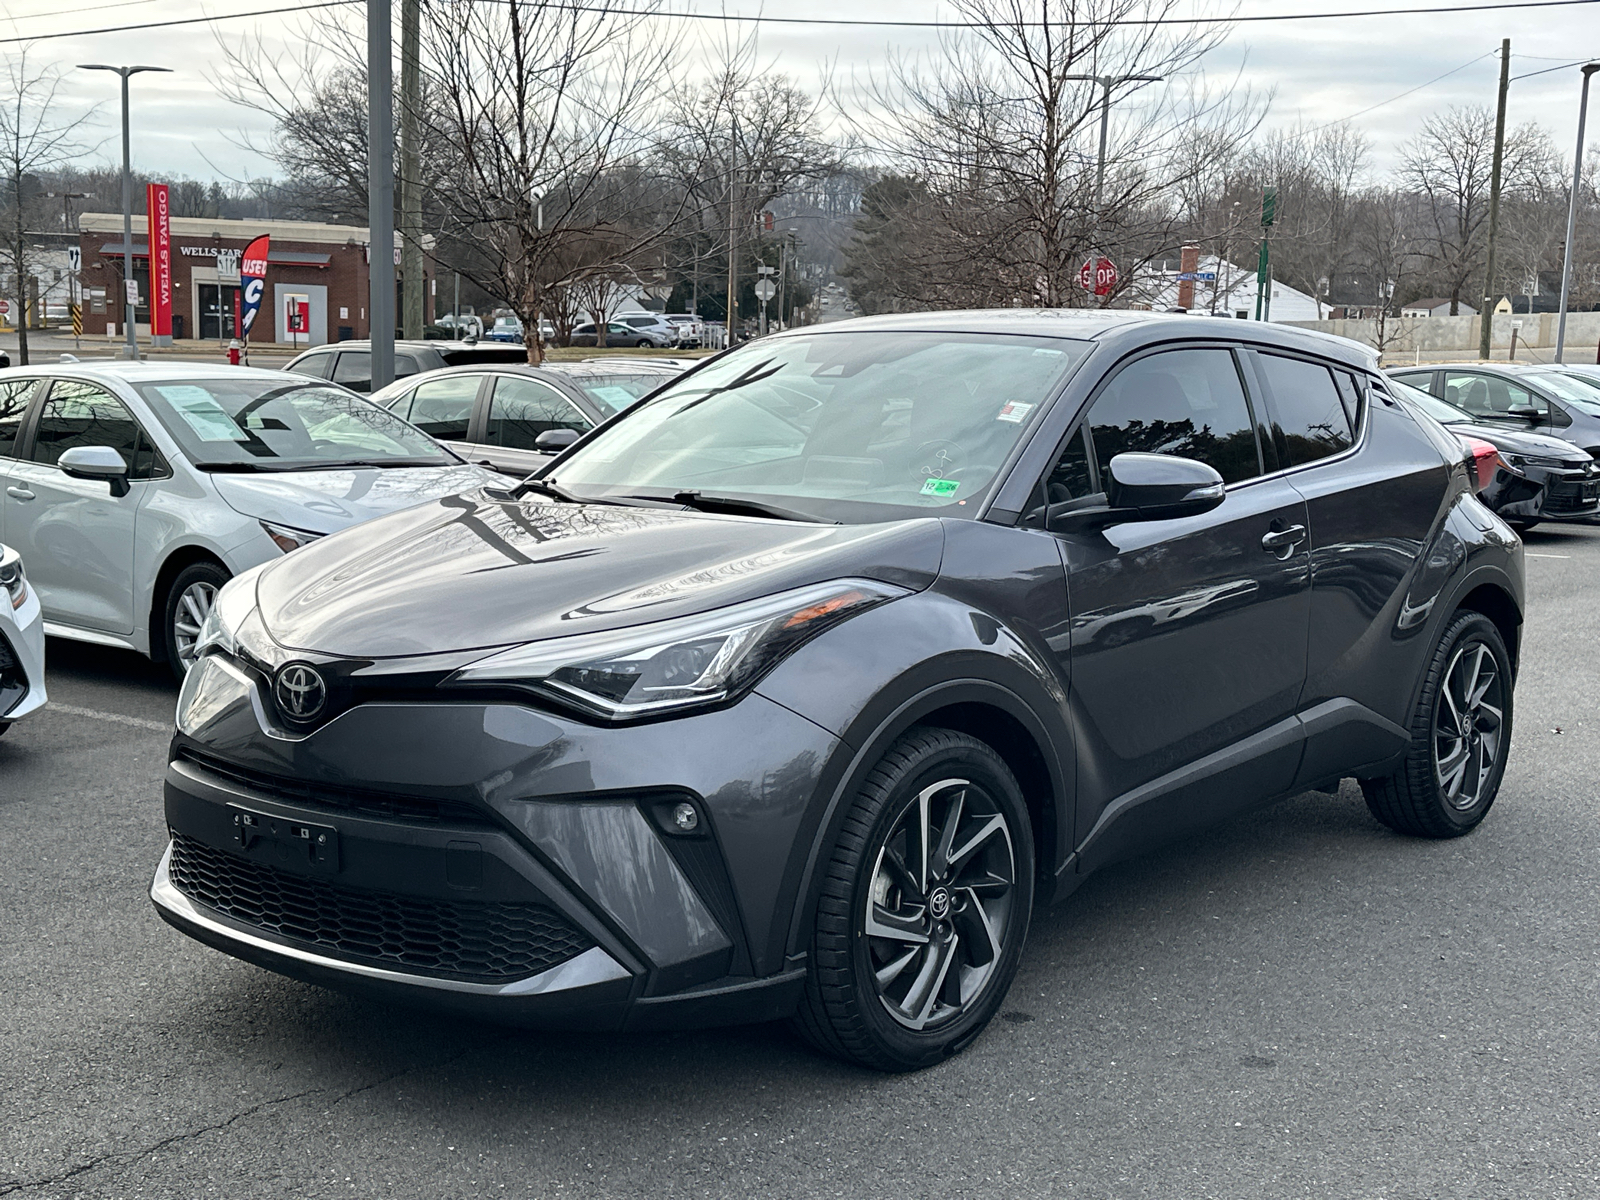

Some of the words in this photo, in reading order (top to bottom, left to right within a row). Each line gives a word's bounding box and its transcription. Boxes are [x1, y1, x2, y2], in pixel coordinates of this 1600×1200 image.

[158, 190, 168, 246] FARGO
[180, 246, 218, 257] WELLS
[220, 248, 243, 258] FAR
[160, 249, 169, 306] WELLS
[1082, 268, 1115, 285] SOP
